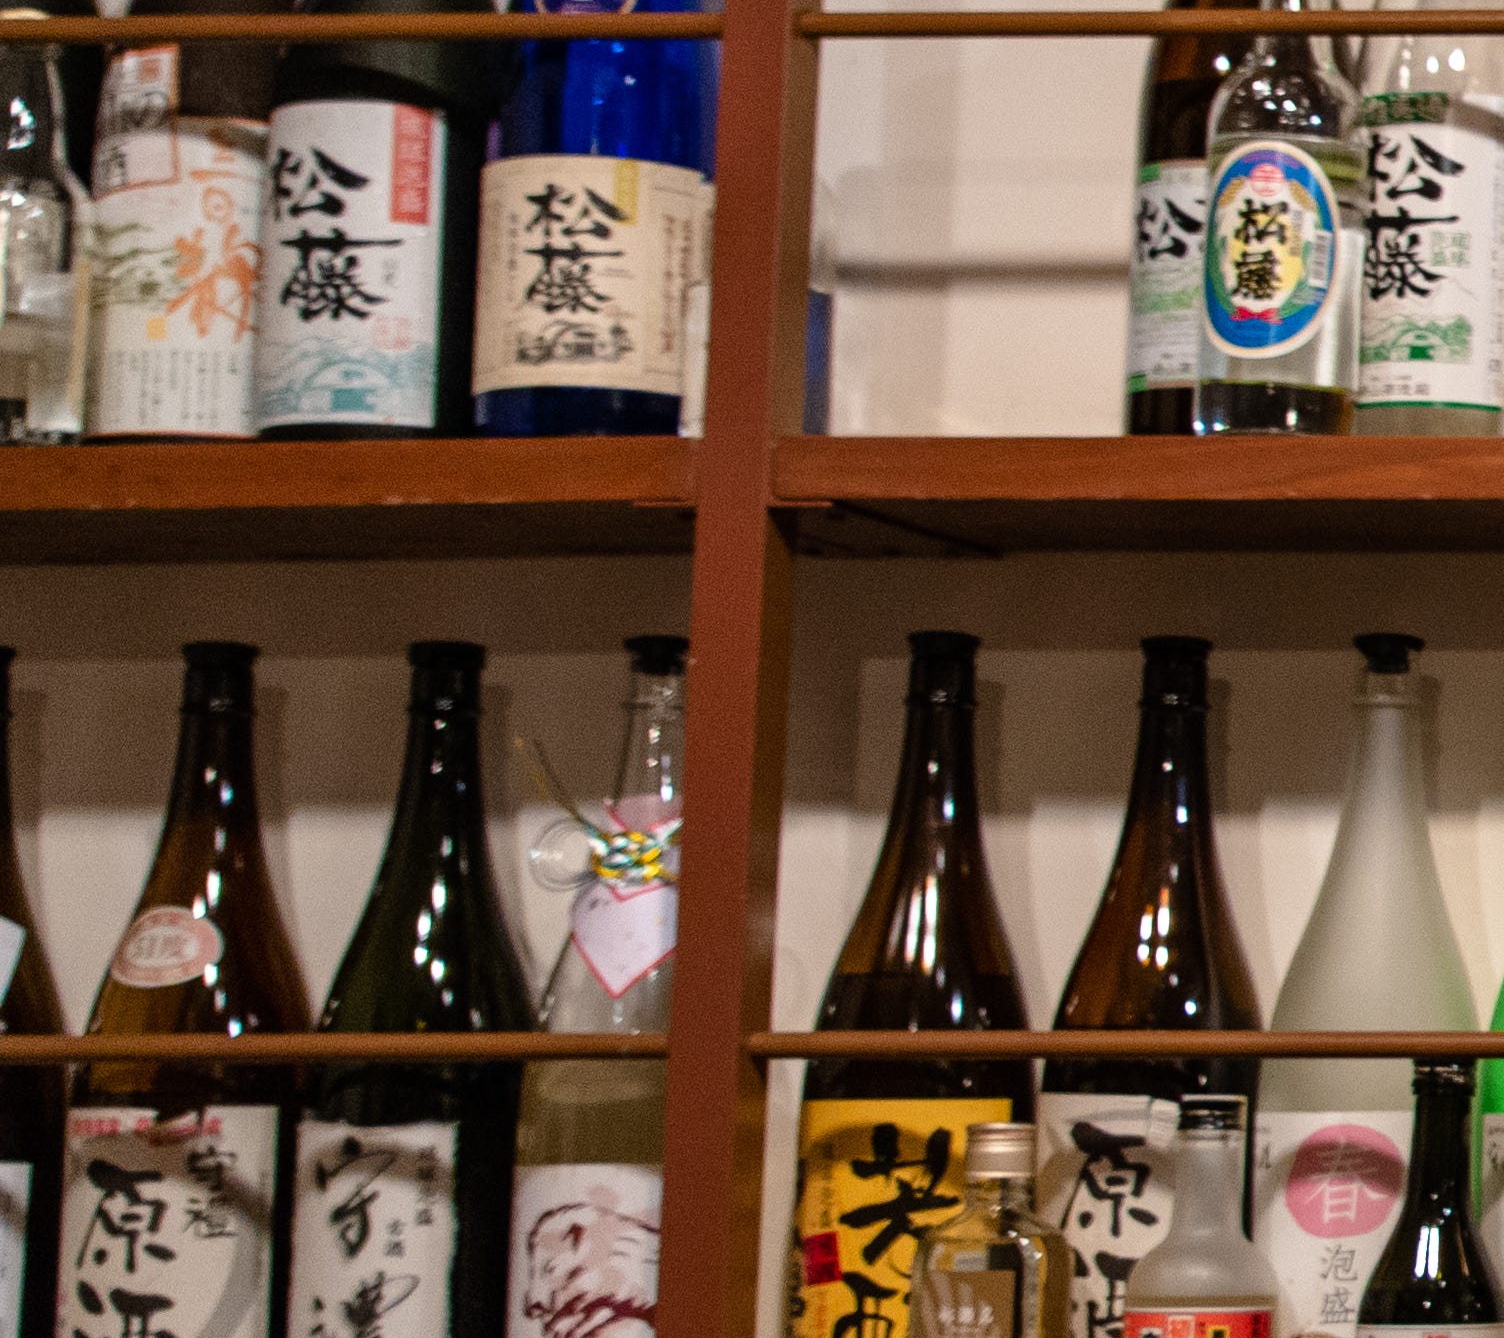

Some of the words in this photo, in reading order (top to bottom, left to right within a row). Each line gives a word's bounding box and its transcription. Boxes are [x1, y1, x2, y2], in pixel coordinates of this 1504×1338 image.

[517, 181, 631, 318] 松藤
[1231, 195, 1290, 303] 松藤
[1302, 1131, 1390, 1226] 春
[1317, 1241, 1362, 1329] 泡盛
